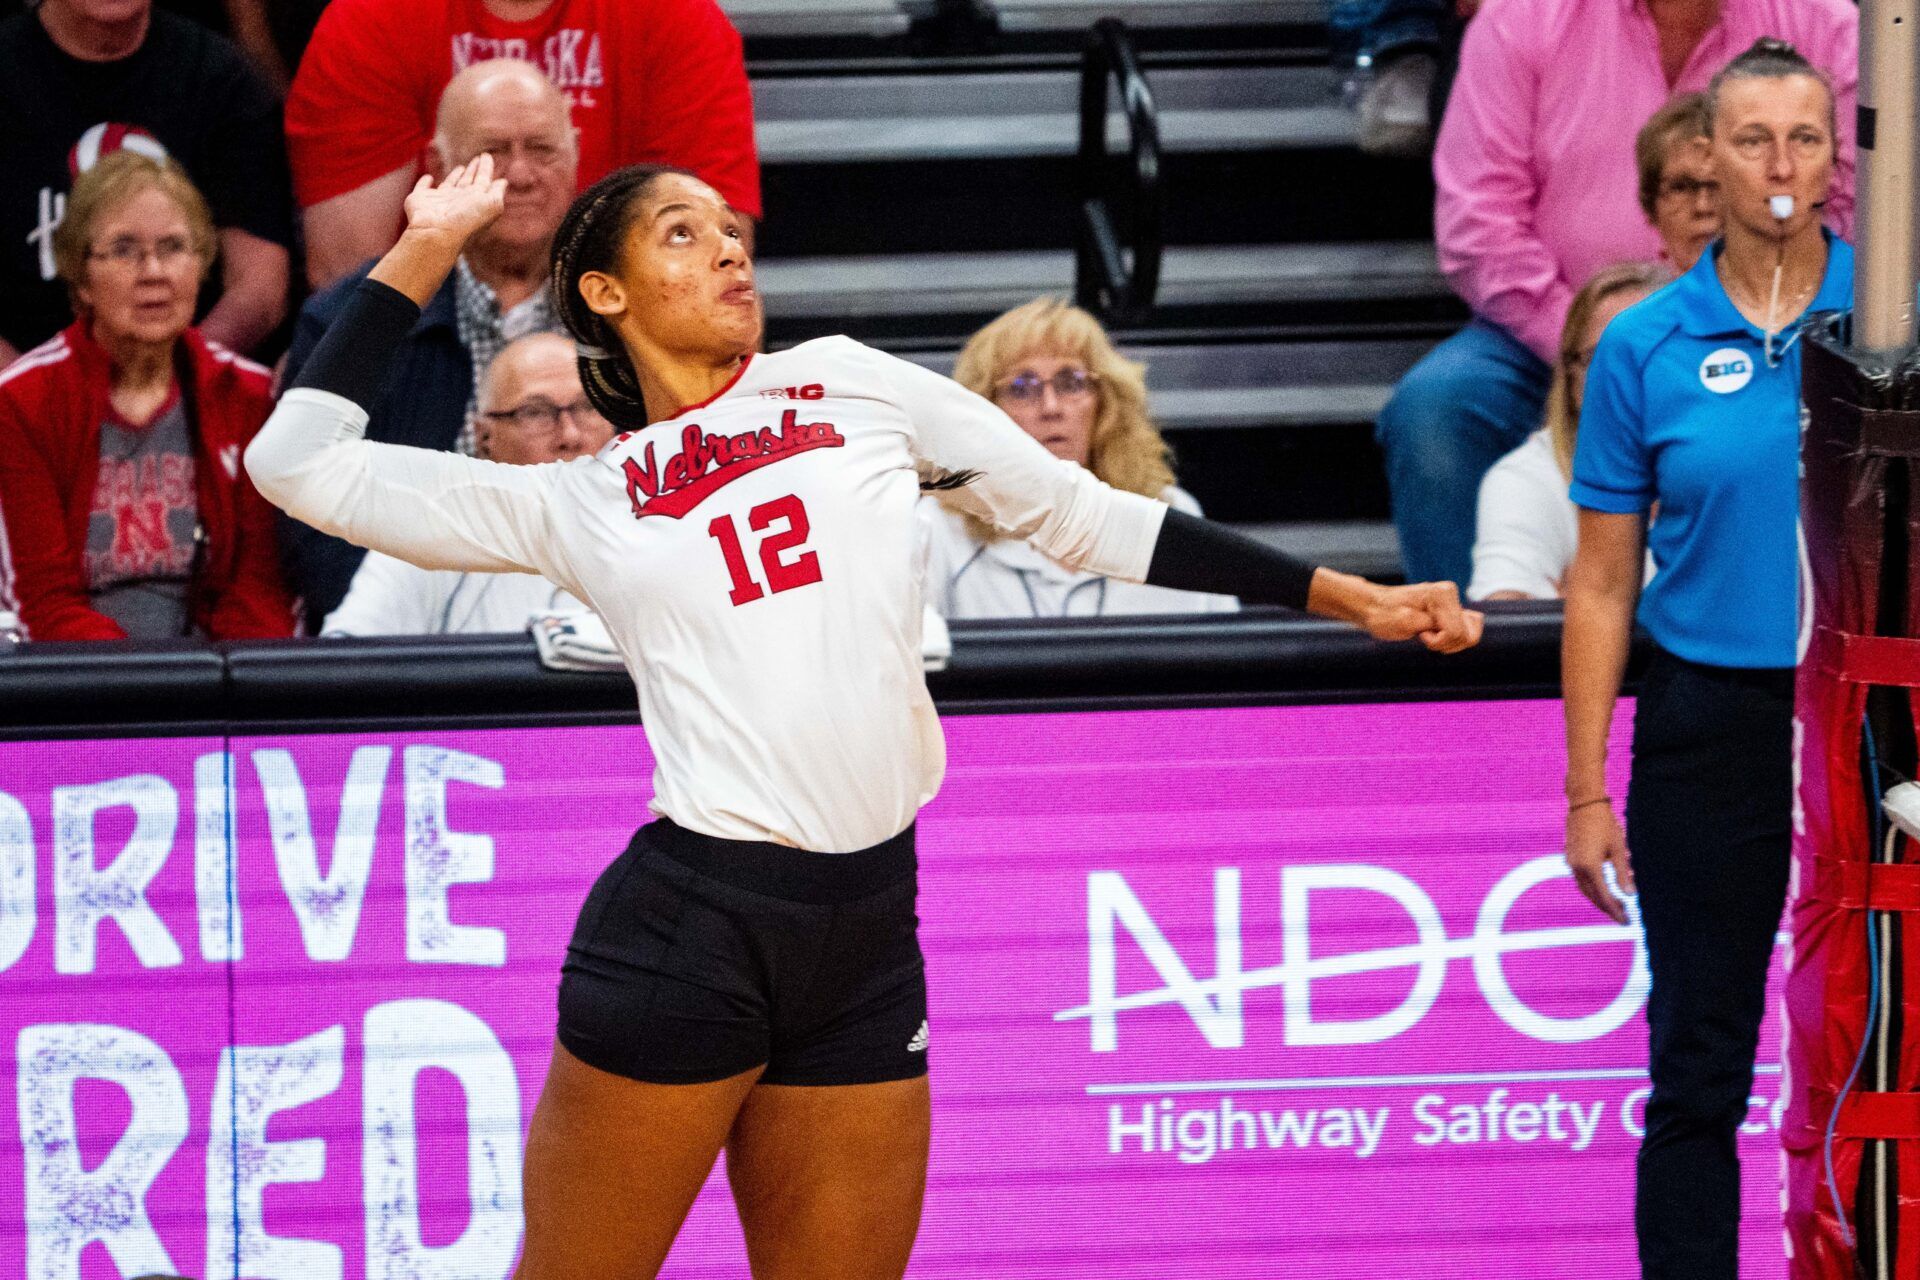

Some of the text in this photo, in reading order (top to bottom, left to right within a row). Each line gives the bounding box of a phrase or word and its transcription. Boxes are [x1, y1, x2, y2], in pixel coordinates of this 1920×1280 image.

[621, 409, 845, 519] Nebraska
[708, 494, 823, 607] 12
[17, 998, 524, 1280] RED
[1108, 1097, 1390, 1163] Highway
[1413, 1088, 1604, 1151] Safety
